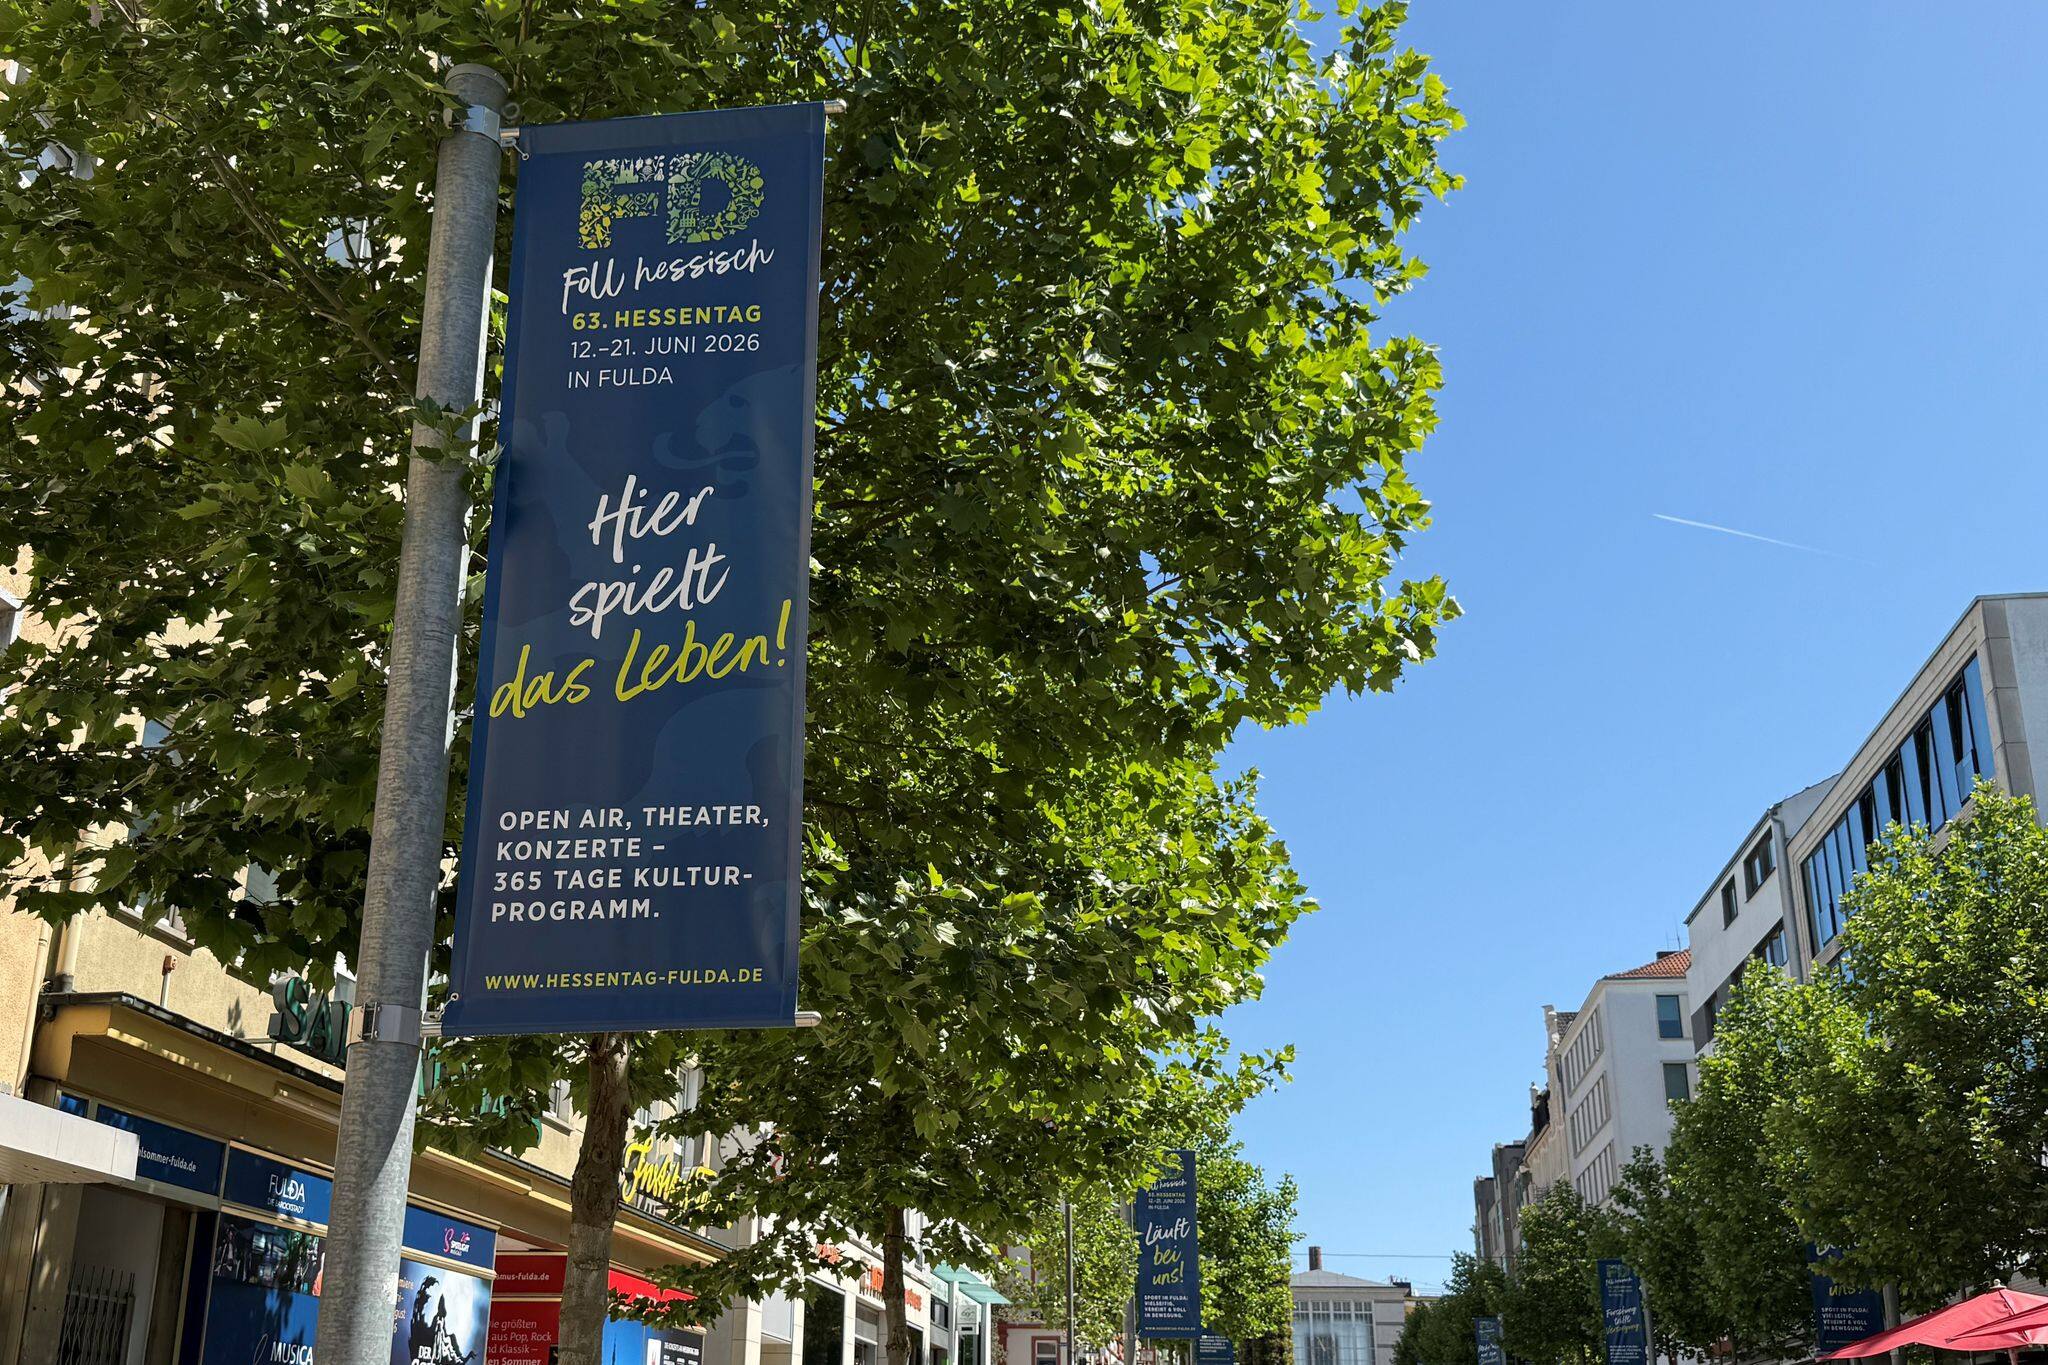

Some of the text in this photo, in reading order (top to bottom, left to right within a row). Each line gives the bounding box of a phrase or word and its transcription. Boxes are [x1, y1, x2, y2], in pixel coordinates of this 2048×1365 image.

[562, 239, 775, 315] Foll hessisch
[572, 305, 762, 331] 63. HESSENTAG
[644, 336, 696, 355] JUNI
[704, 333, 761, 353] 2026
[567, 366, 674, 389] IN FULDA
[588, 474, 715, 564] Hier
[568, 543, 731, 640] spielt
[489, 599, 792, 719] das Leben!
[499, 805, 770, 831] OPEN AIR, THEATER,
[496, 837, 643, 862] KONZERTE
[493, 865, 753, 893] 365 TAGE KULTUR-
[491, 898, 661, 923] PROGRAMM.
[485, 967, 764, 990] WWW.HESSENTAG-FULDA.DE
[269, 1174, 306, 1203] FULDA
[1145, 1217, 1191, 1246] Läuft
[1153, 1244, 1181, 1266] bei
[1152, 1261, 1185, 1285] uns!
[491, 1333, 508, 1341] aus
[531, 1331, 552, 1342] Rock
[501, 1318, 537, 1330] größten
[500, 1343, 530, 1354] Klassik
